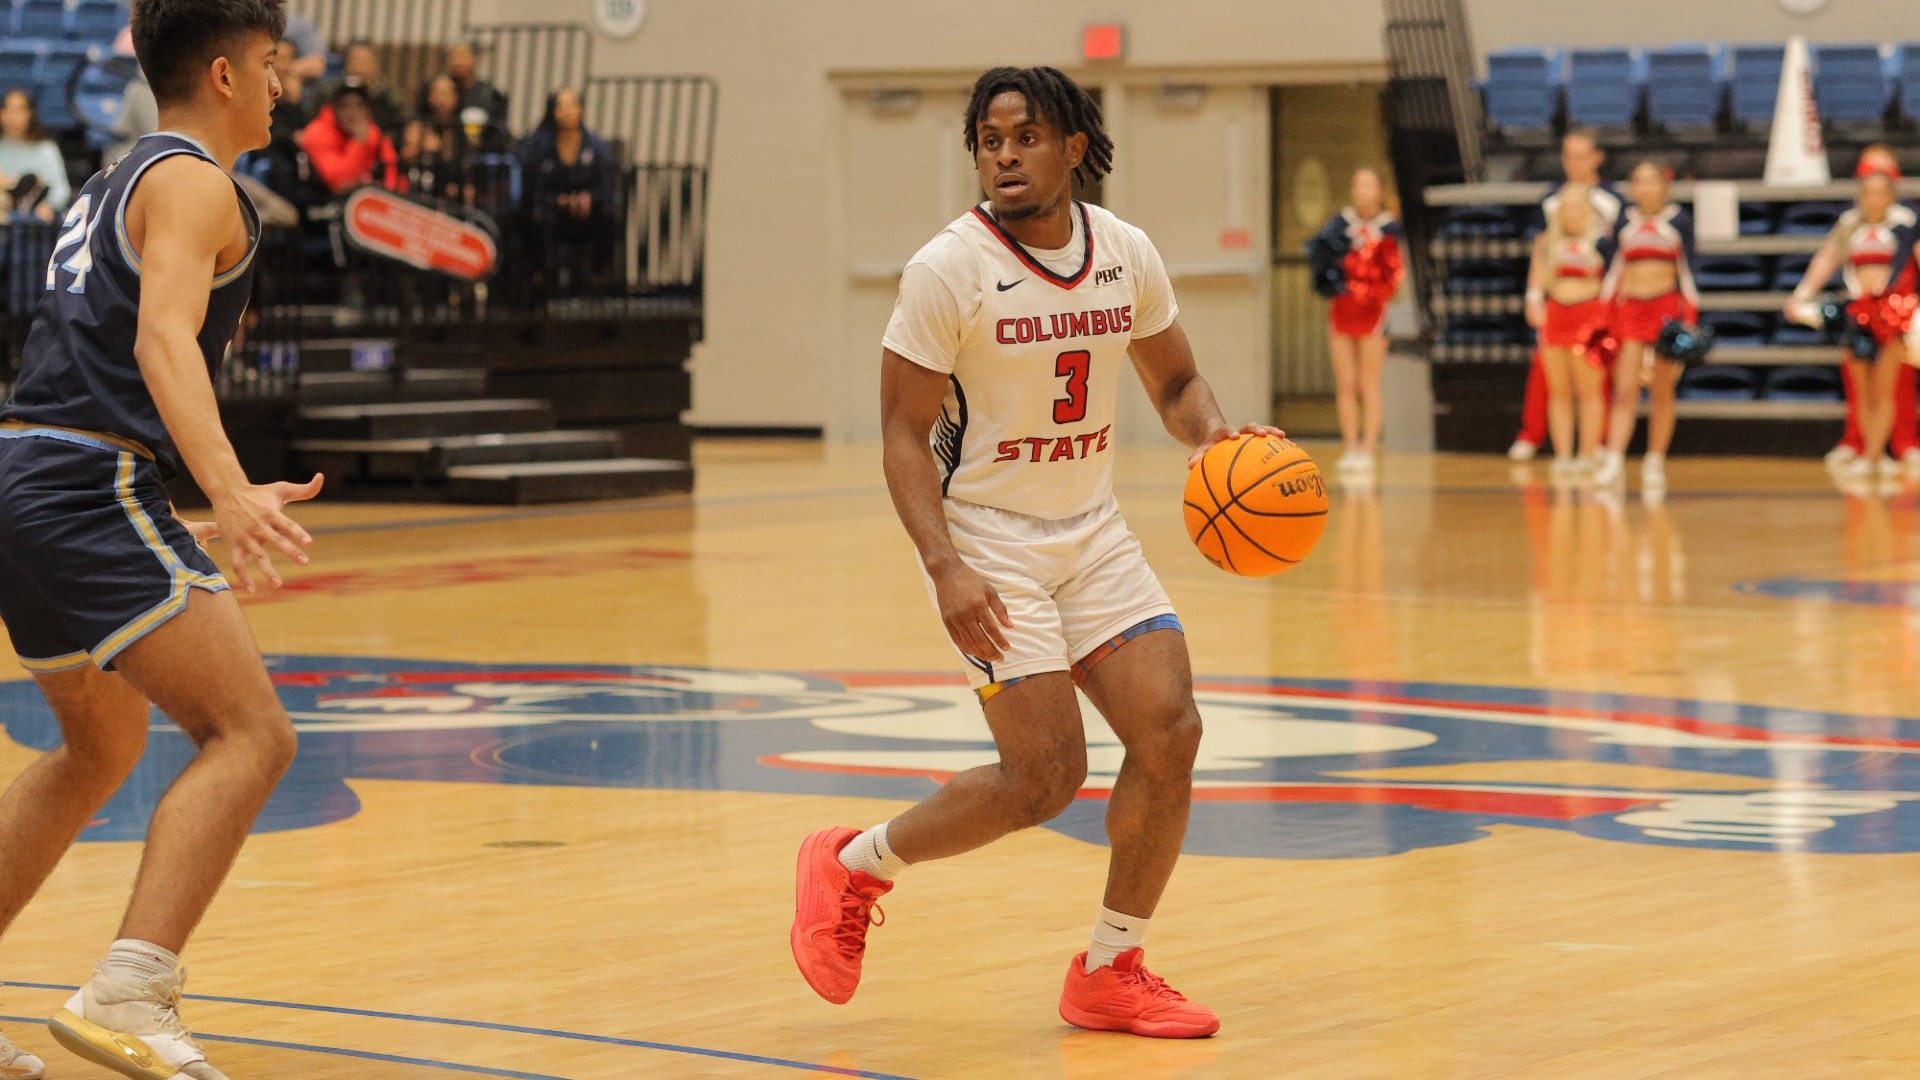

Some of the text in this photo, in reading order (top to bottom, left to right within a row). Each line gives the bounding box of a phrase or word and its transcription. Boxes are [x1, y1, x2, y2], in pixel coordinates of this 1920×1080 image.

[46, 188, 110, 293] 24
[1095, 266, 1123, 286] PBC
[996, 305, 1132, 344] COLUMBUS
[1053, 349, 1091, 424] 3
[993, 424, 1111, 463] STATE
[1279, 474, 1325, 498] lson
